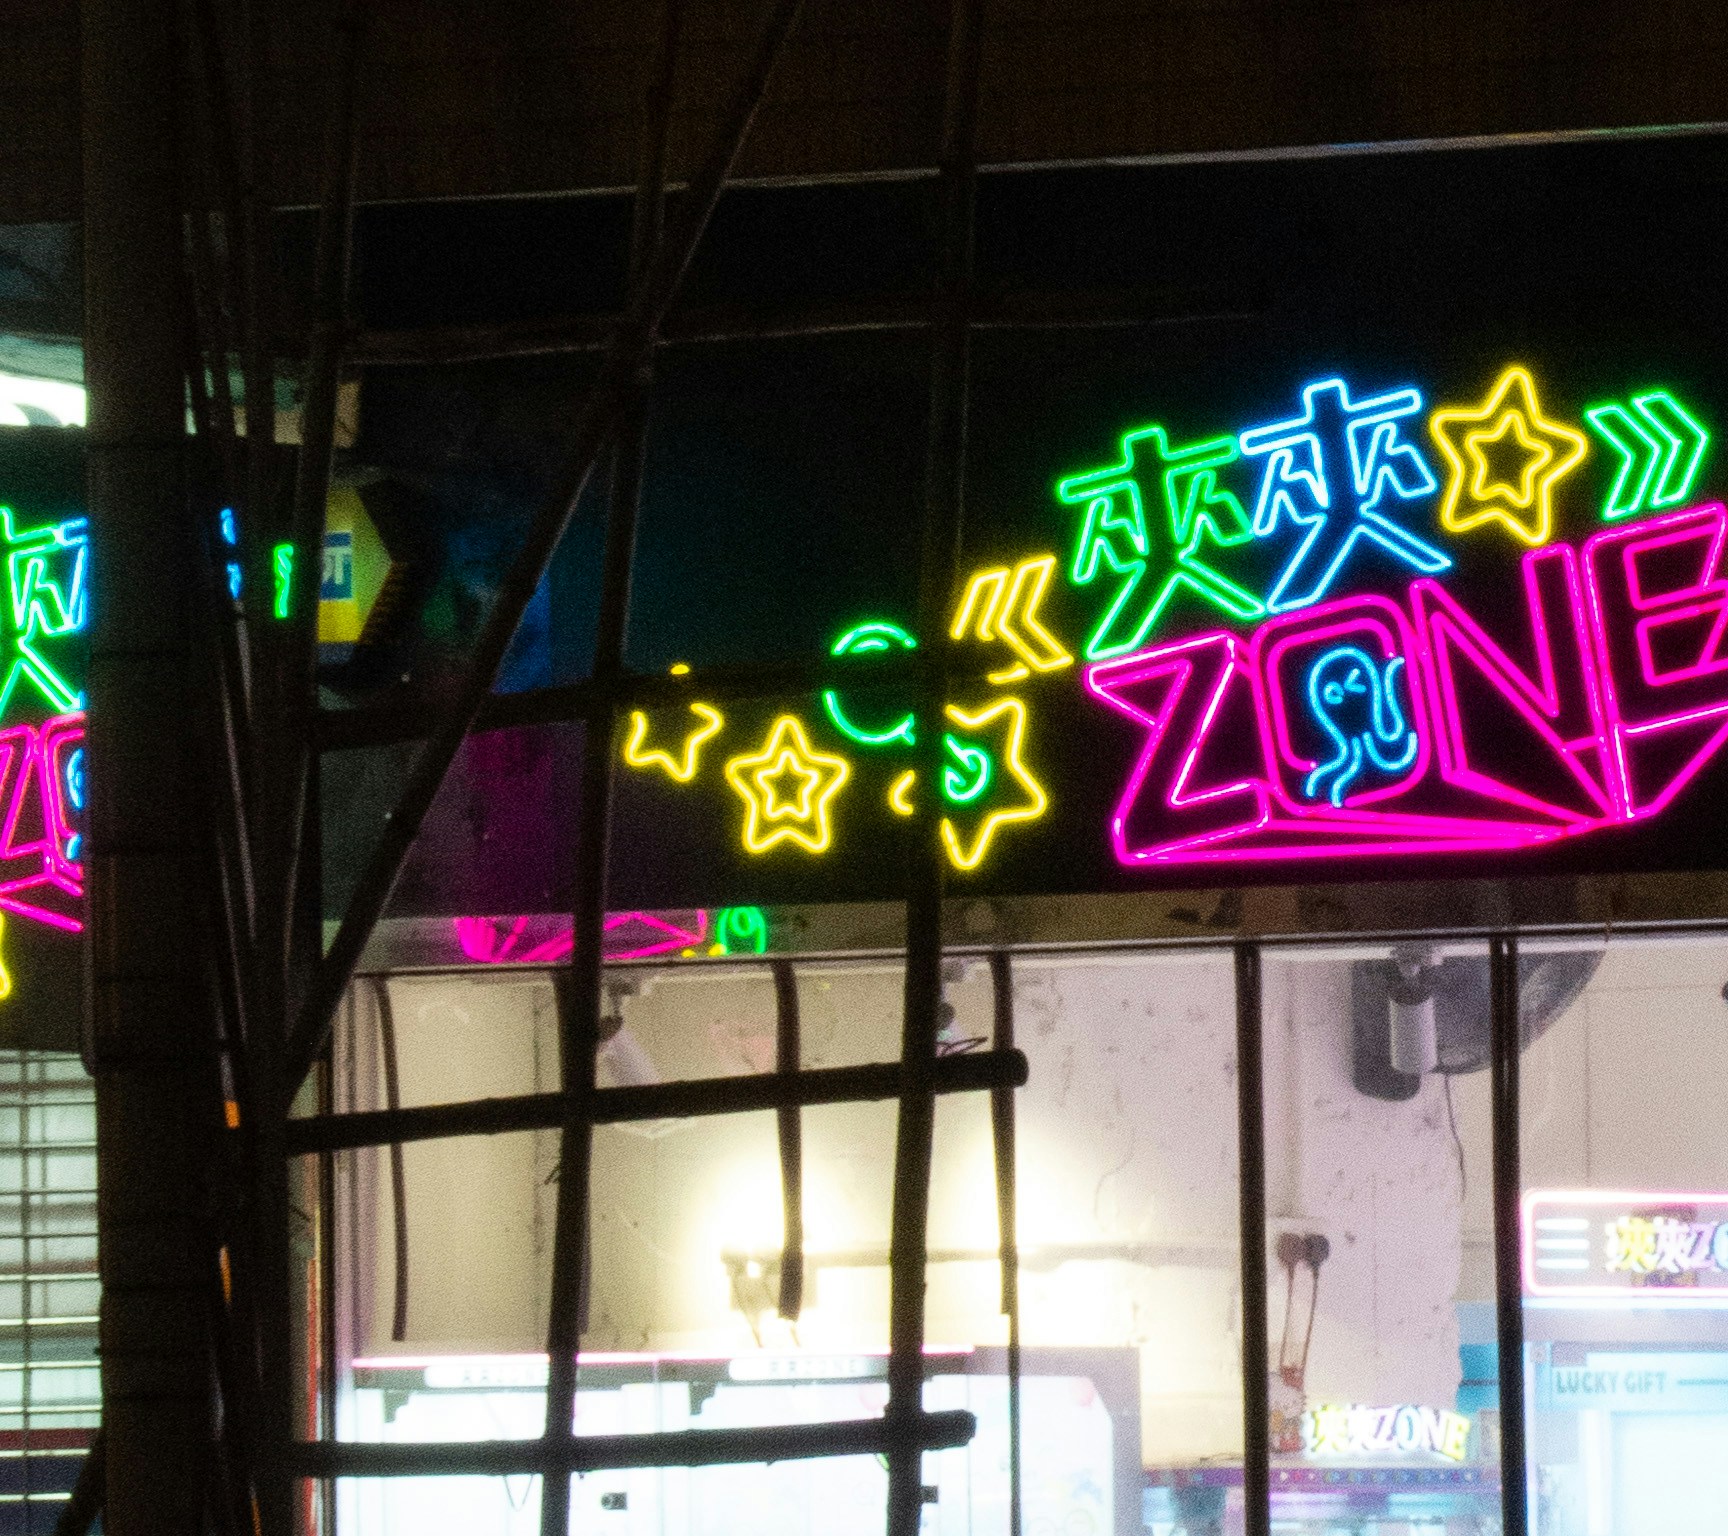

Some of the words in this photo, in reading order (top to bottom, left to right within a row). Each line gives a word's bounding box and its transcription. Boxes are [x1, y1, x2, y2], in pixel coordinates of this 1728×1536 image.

[1058, 376, 1453, 660] 夾夾
[1556, 1370, 1623, 1394] LUCKY
[1626, 1370, 1668, 1394] GIFT
